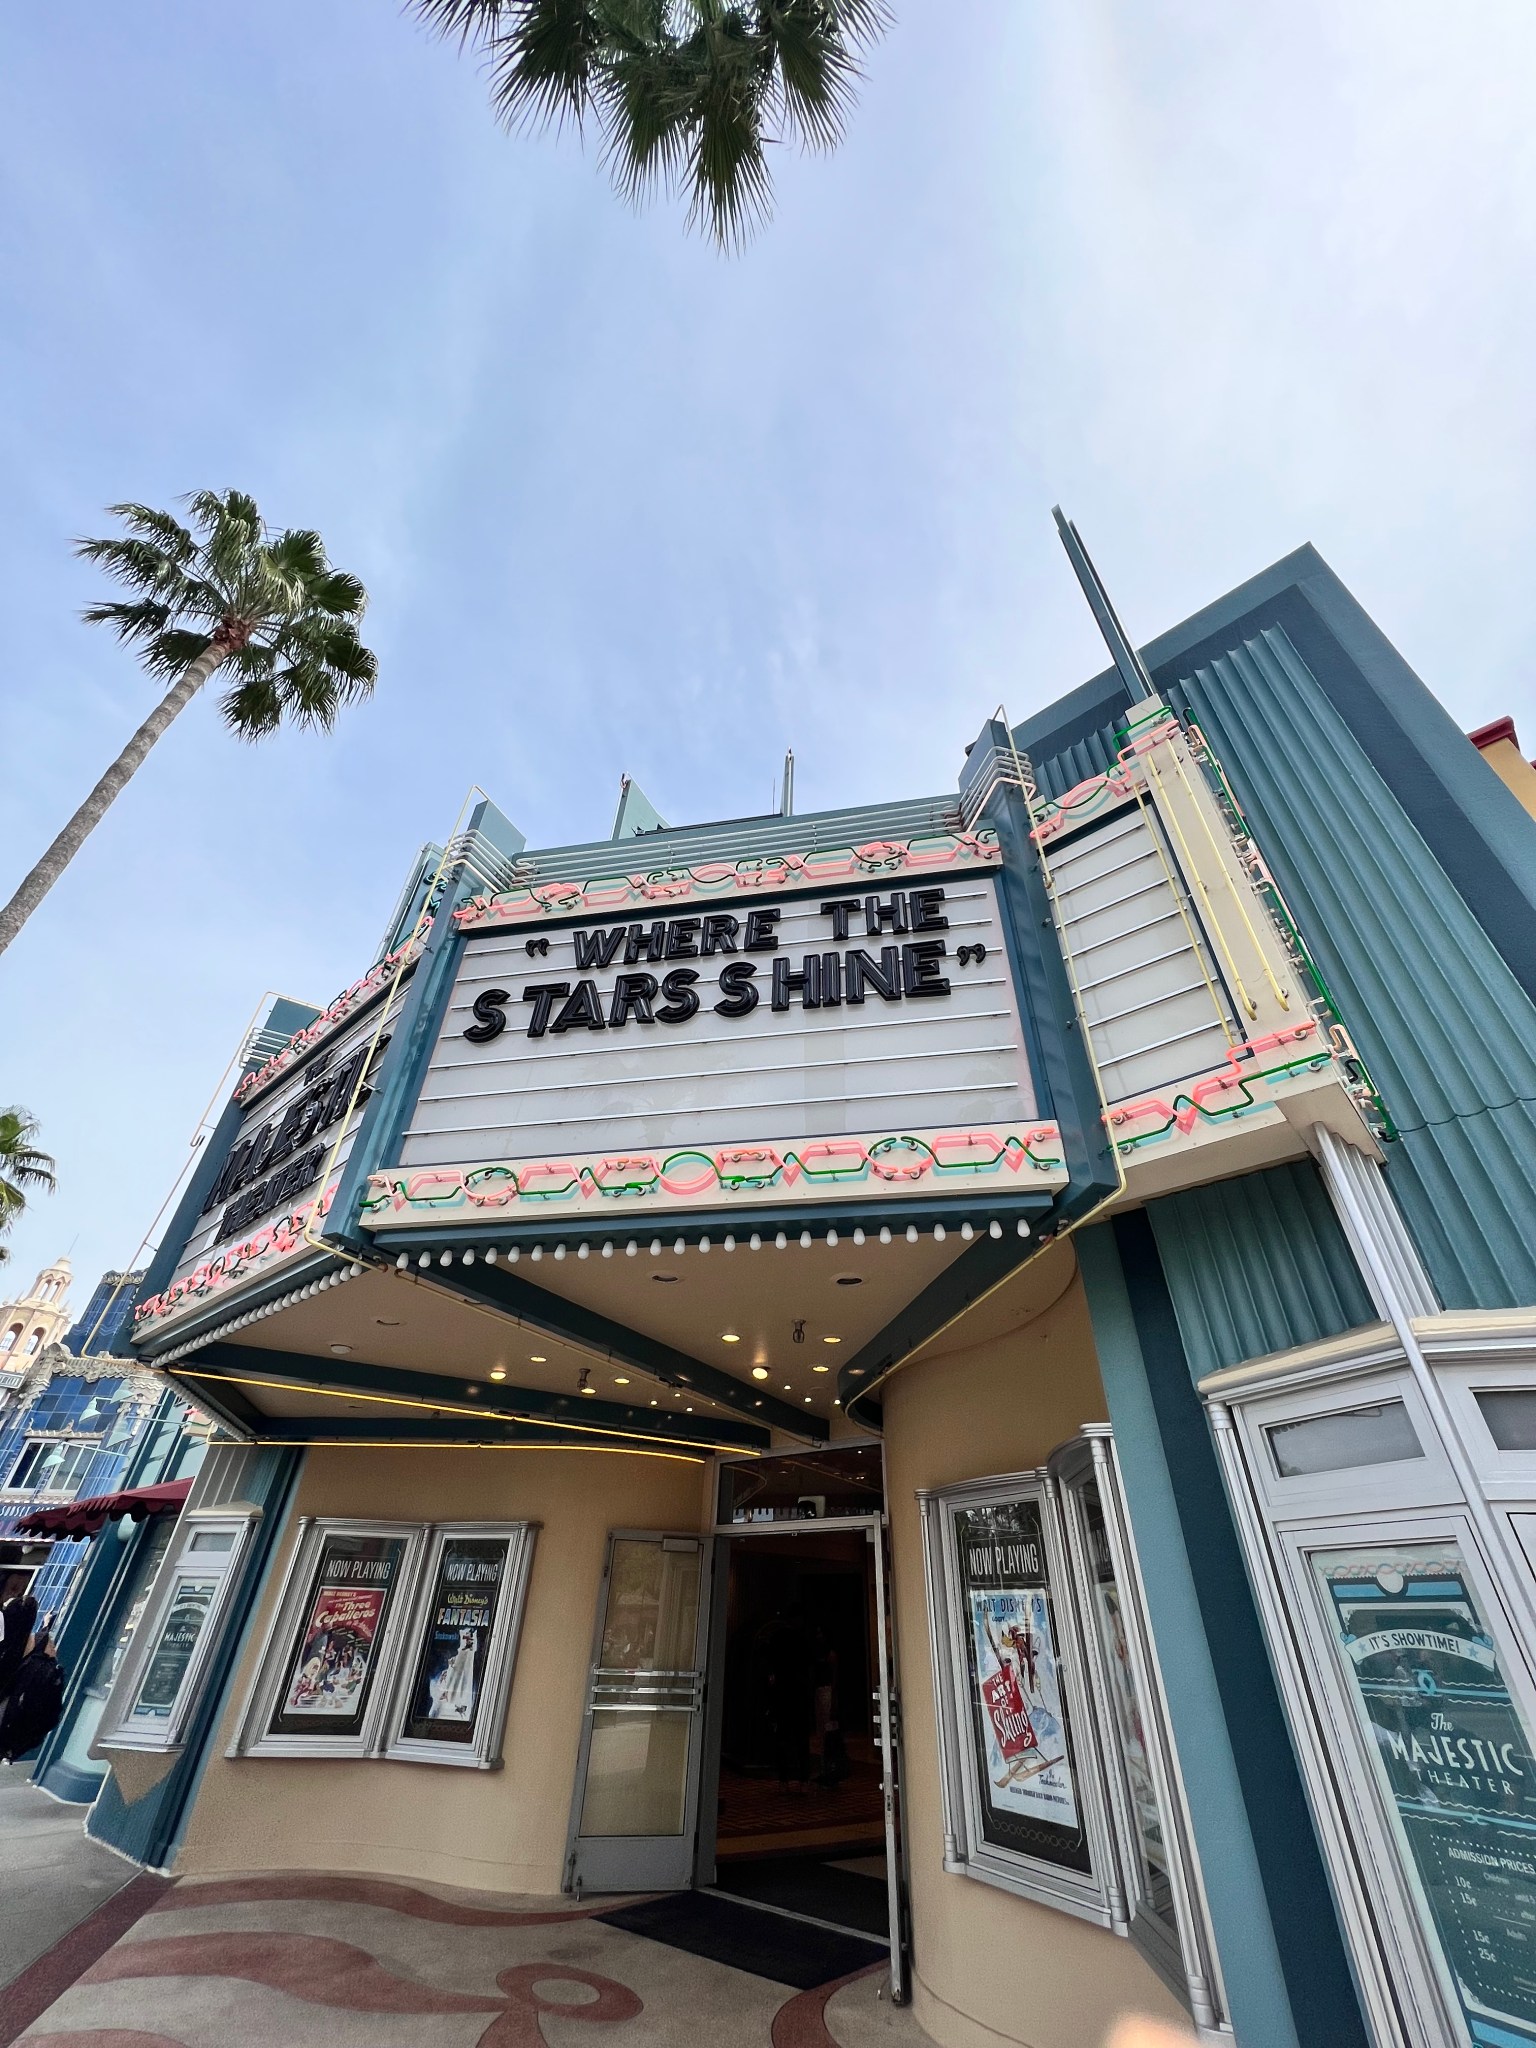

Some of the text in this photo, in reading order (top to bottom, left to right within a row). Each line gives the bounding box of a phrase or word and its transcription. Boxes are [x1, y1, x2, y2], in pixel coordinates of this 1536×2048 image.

[820, 888, 949, 941] THE
[462, 968, 701, 1043] STARS
[326, 1560, 391, 1580] NOW PLAYING
[969, 1543, 1039, 1576] NOW PLAYING
[447, 1563, 498, 1582] NOW PLAYING
[342, 1601, 371, 1611] Three
[464, 1593, 488, 1606] Disney's
[315, 1608, 376, 1629] Caballeros
[437, 1608, 490, 1626] FANTASIA
[1369, 1632, 1461, 1654] IT'S SHOWTIME!
[992, 1674, 1004, 1687] THE
[991, 1680, 1012, 1703] ART
[1000, 1694, 1009, 1707] OF
[994, 1708, 1032, 1748] Skiing
[1430, 1712, 1454, 1732] The
[1386, 1730, 1524, 1776] MAJESTIC
[1415, 1766, 1514, 1795] THEATER
[1448, 1847, 1536, 1874] ADMISSION PRICES
